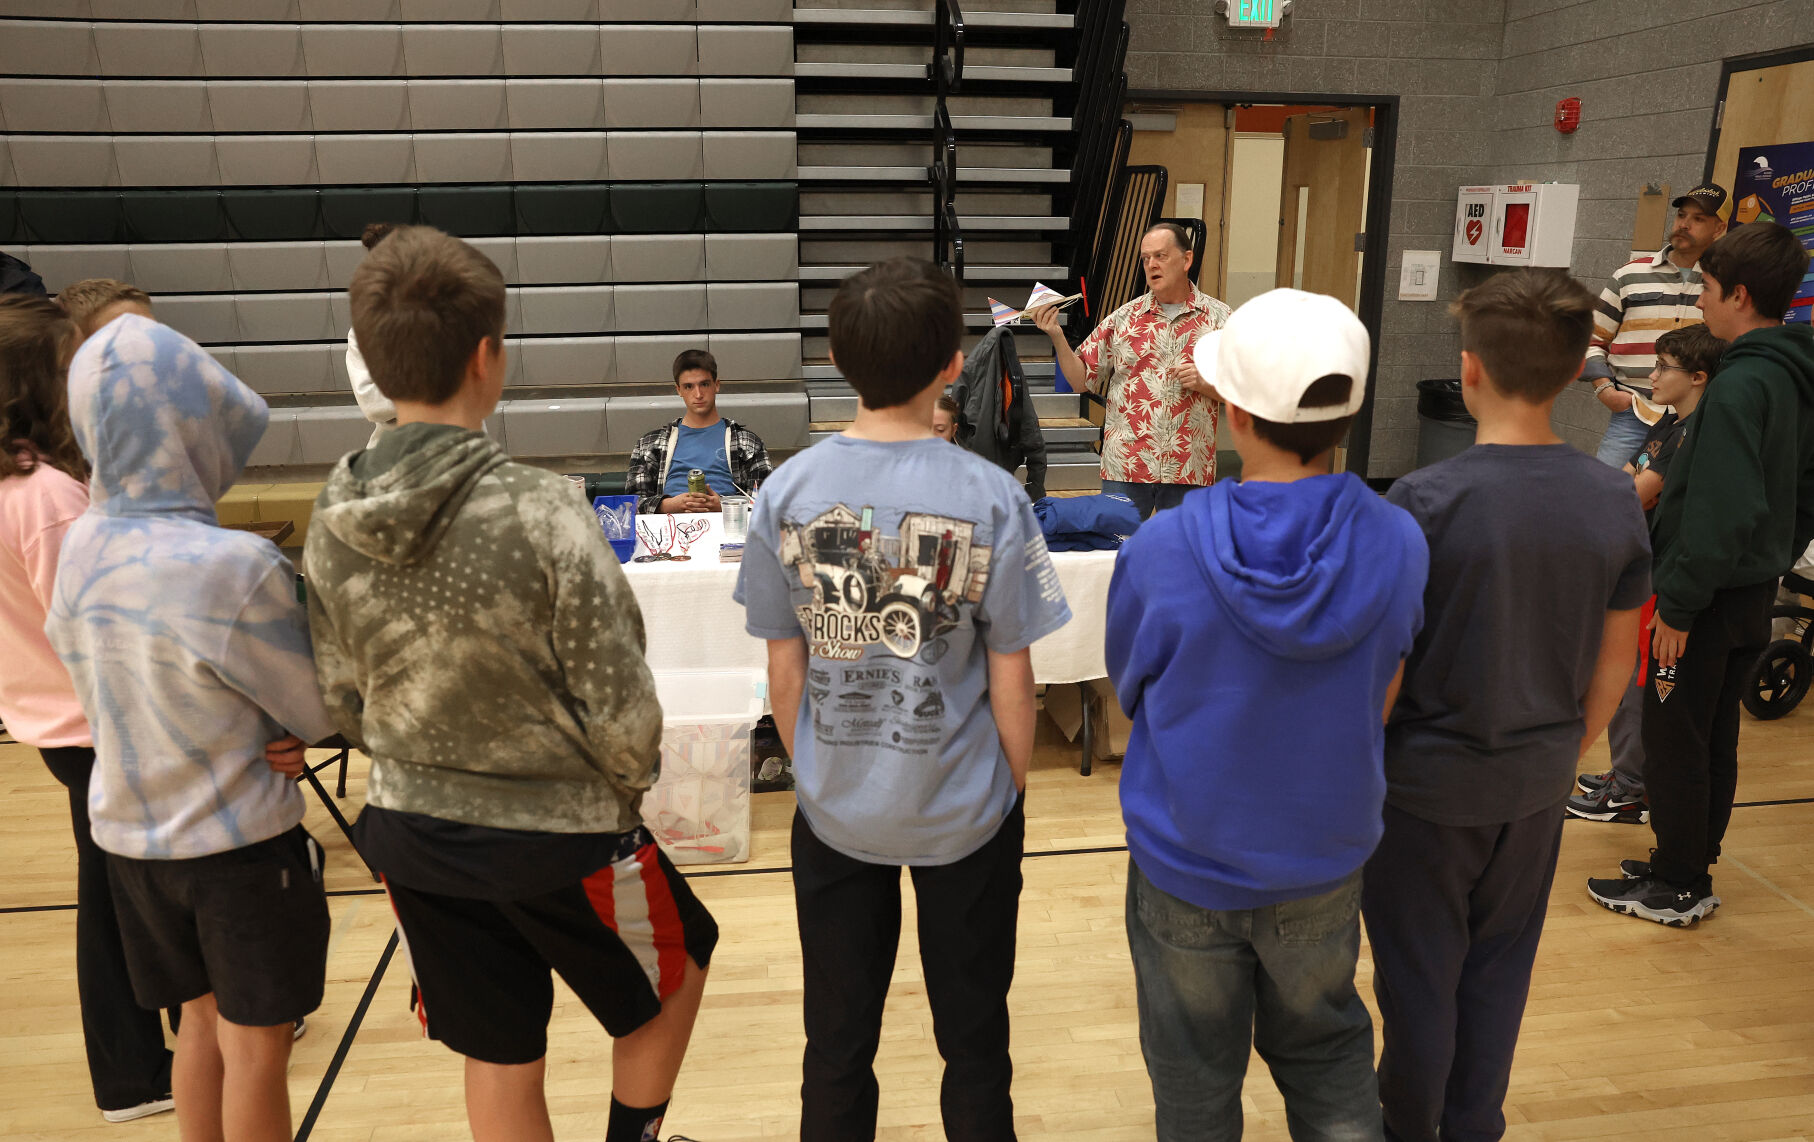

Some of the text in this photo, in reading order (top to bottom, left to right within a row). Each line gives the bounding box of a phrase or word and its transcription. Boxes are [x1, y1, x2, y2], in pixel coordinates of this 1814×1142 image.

[1239, 0, 1273, 21] EXIT
[1507, 185, 1524, 193] TRAUMA
[1468, 203, 1485, 218] AED
[819, 640, 862, 660] Show
[843, 668, 901, 684] ERNIE'S
